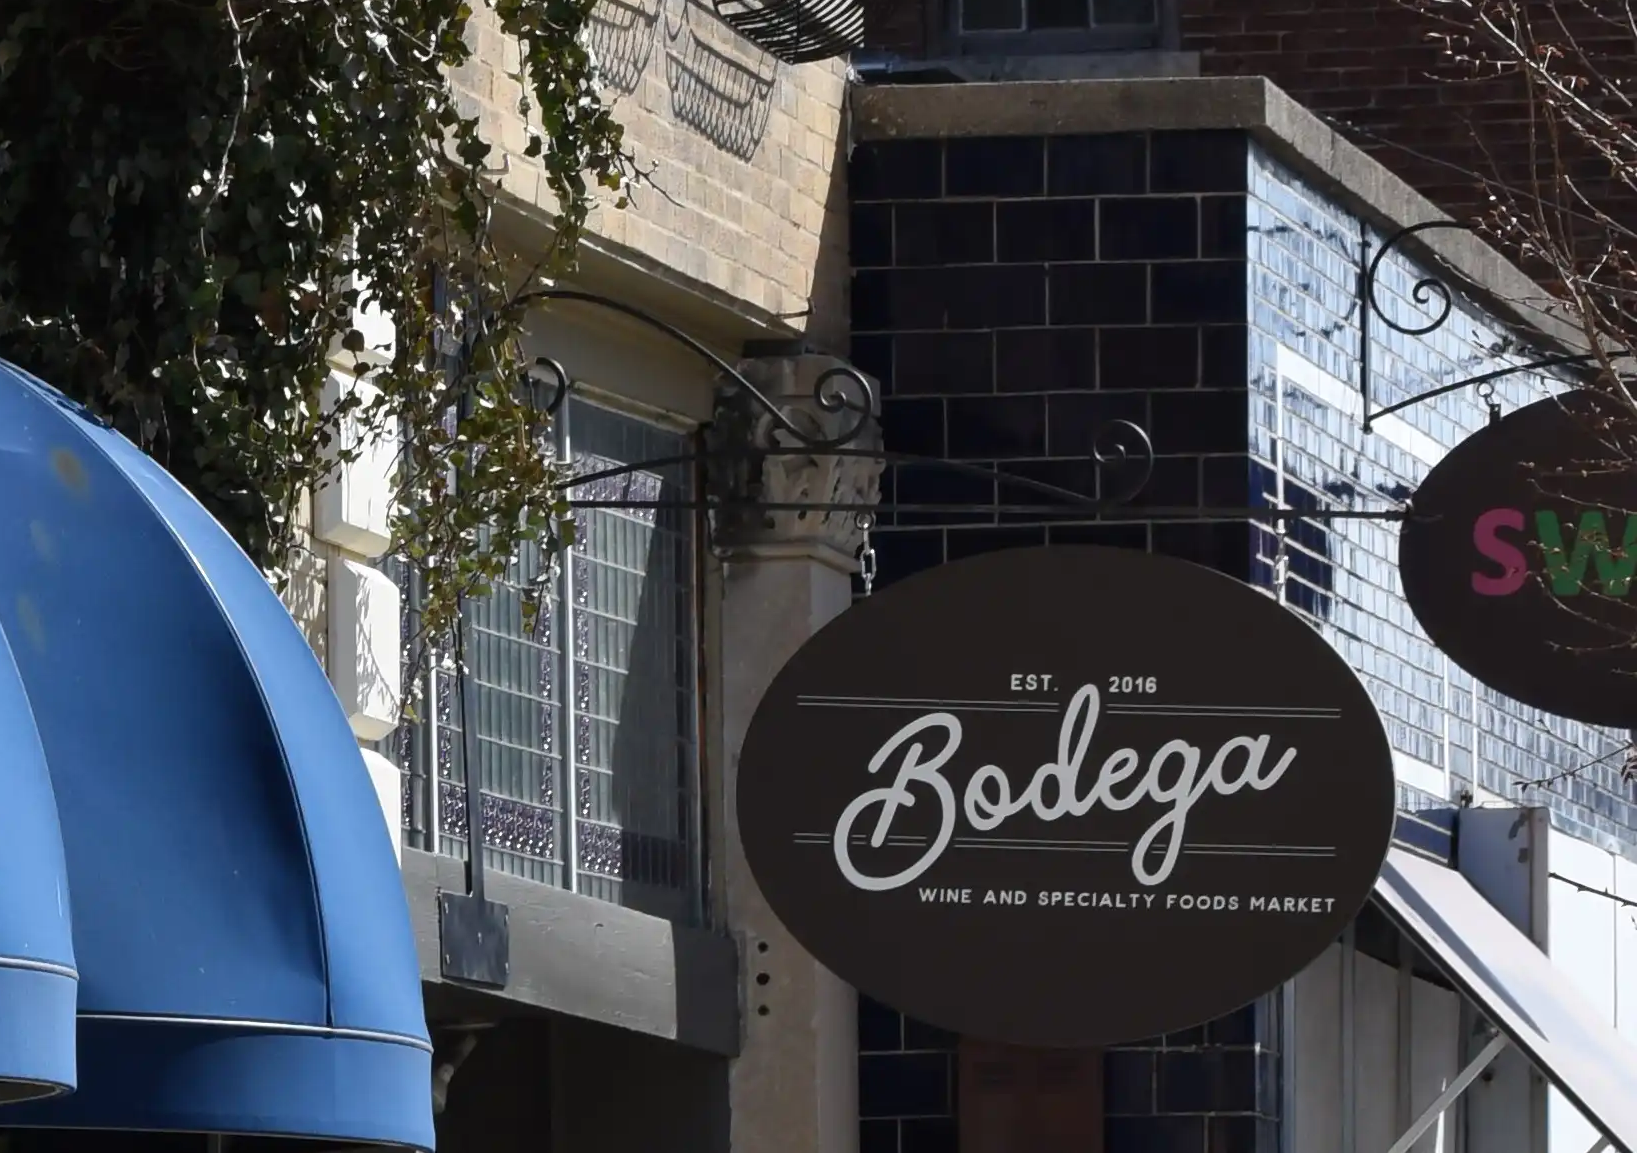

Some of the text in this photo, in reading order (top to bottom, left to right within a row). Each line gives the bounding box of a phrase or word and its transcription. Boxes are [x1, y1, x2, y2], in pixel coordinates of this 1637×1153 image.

[1010, 673, 1158, 694] EST. 2016
[833, 683, 1298, 891] Bodega
[918, 887, 1337, 913] WINE AND SPECIALTY FOODS MARKET
